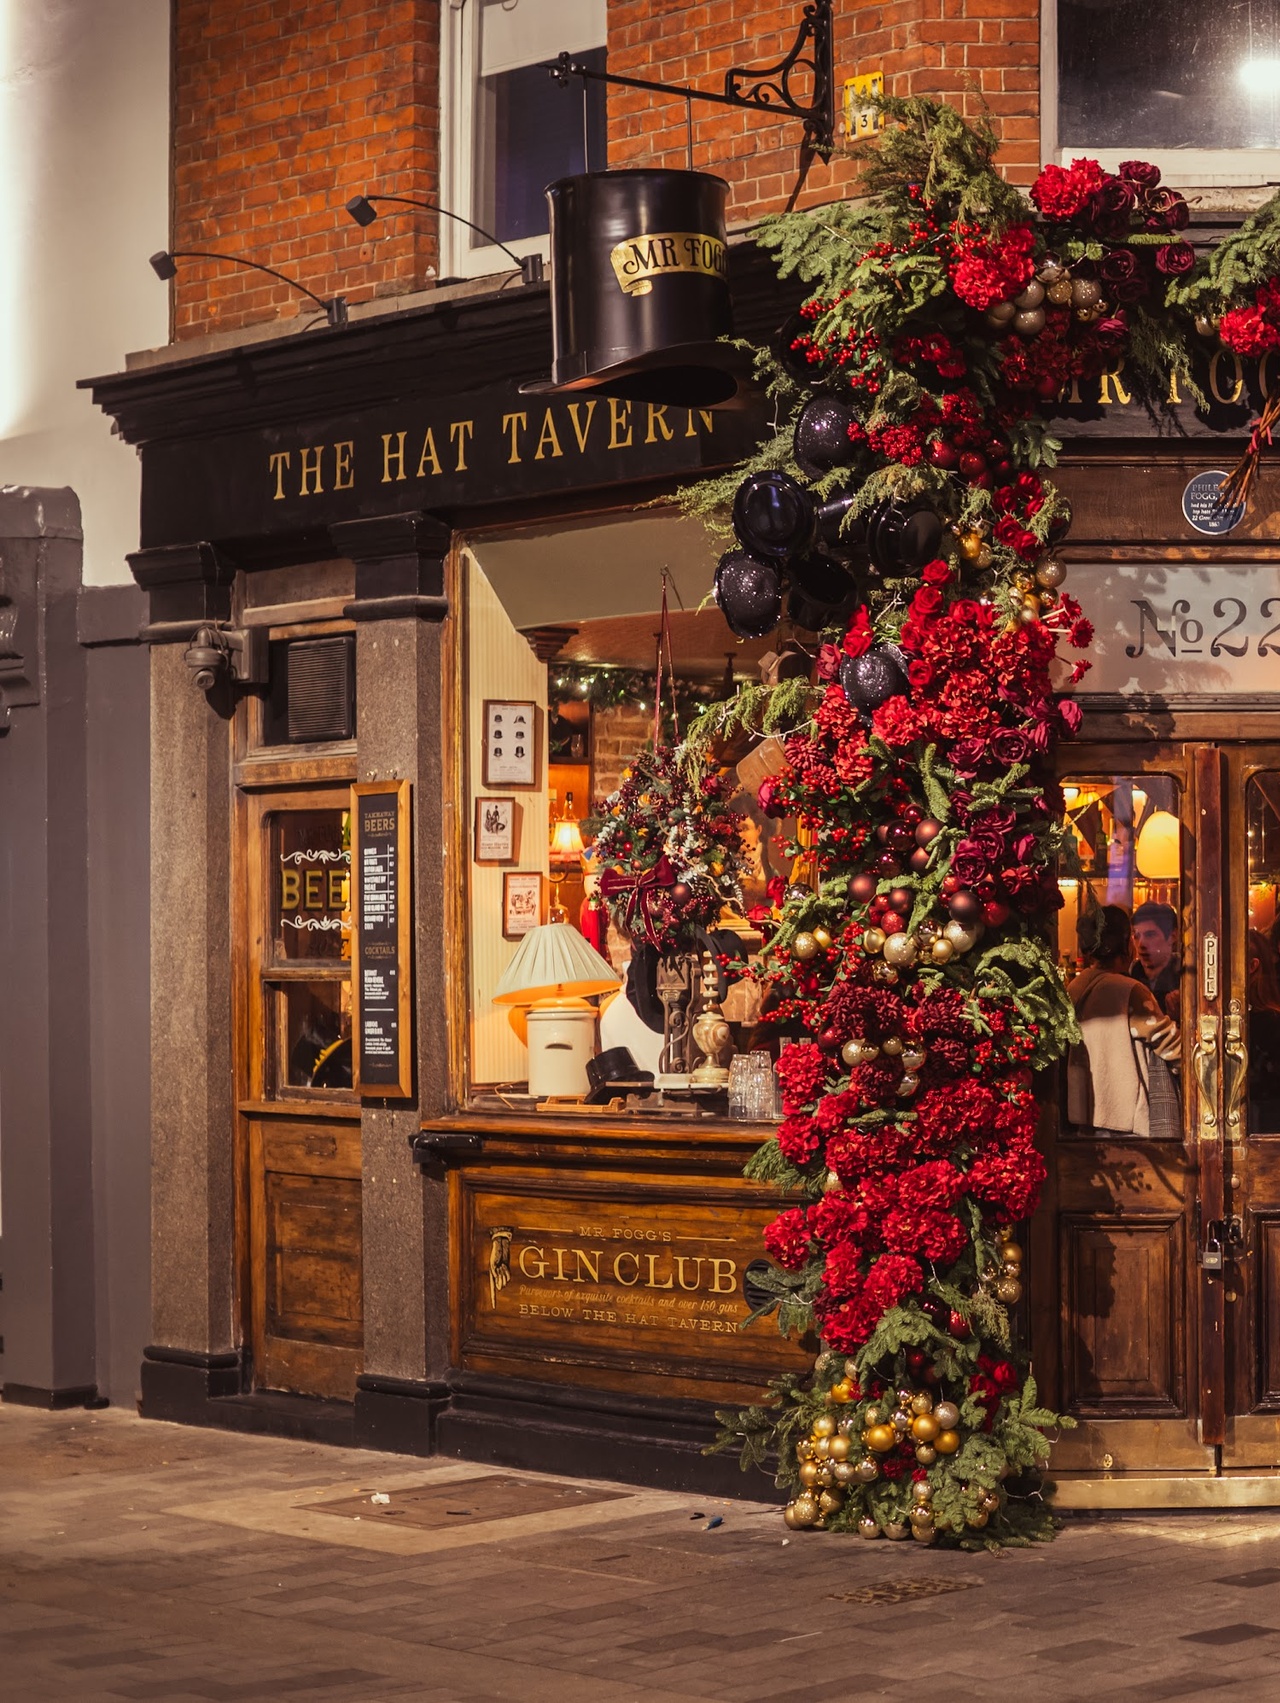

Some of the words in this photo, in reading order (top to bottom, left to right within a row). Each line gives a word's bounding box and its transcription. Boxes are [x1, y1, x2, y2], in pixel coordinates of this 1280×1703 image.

[860, 114, 868, 128] 3
[622, 237, 681, 275] MR
[269, 440, 355, 500] THE
[380, 420, 474, 483] HAT
[502, 398, 714, 464] TAVERN
[364, 817, 395, 832] BEERS
[281, 868, 346, 910] BEE
[364, 946, 395, 955] COCKTAILS
[1207, 940, 1215, 994] PULL
[579, 1226, 605, 1239] MR
[612, 1227, 672, 1242] FOGG'S
[518, 1245, 603, 1283] GIN
[613, 1251, 738, 1294] CLUB
[518, 1284, 561, 1299] Purveyors
[563, 1288, 575, 1302] of
[575, 1290, 613, 1304] exquisite
[615, 1294, 656, 1306] cocktails
[657, 1297, 675, 1308] and
[678, 1300, 697, 1310] over
[717, 1303, 739, 1315] gins
[518, 1303, 575, 1318] BELOW
[582, 1309, 618, 1322] THE
[624, 1313, 659, 1326] HAT
[667, 1316, 739, 1333] TAVERN
